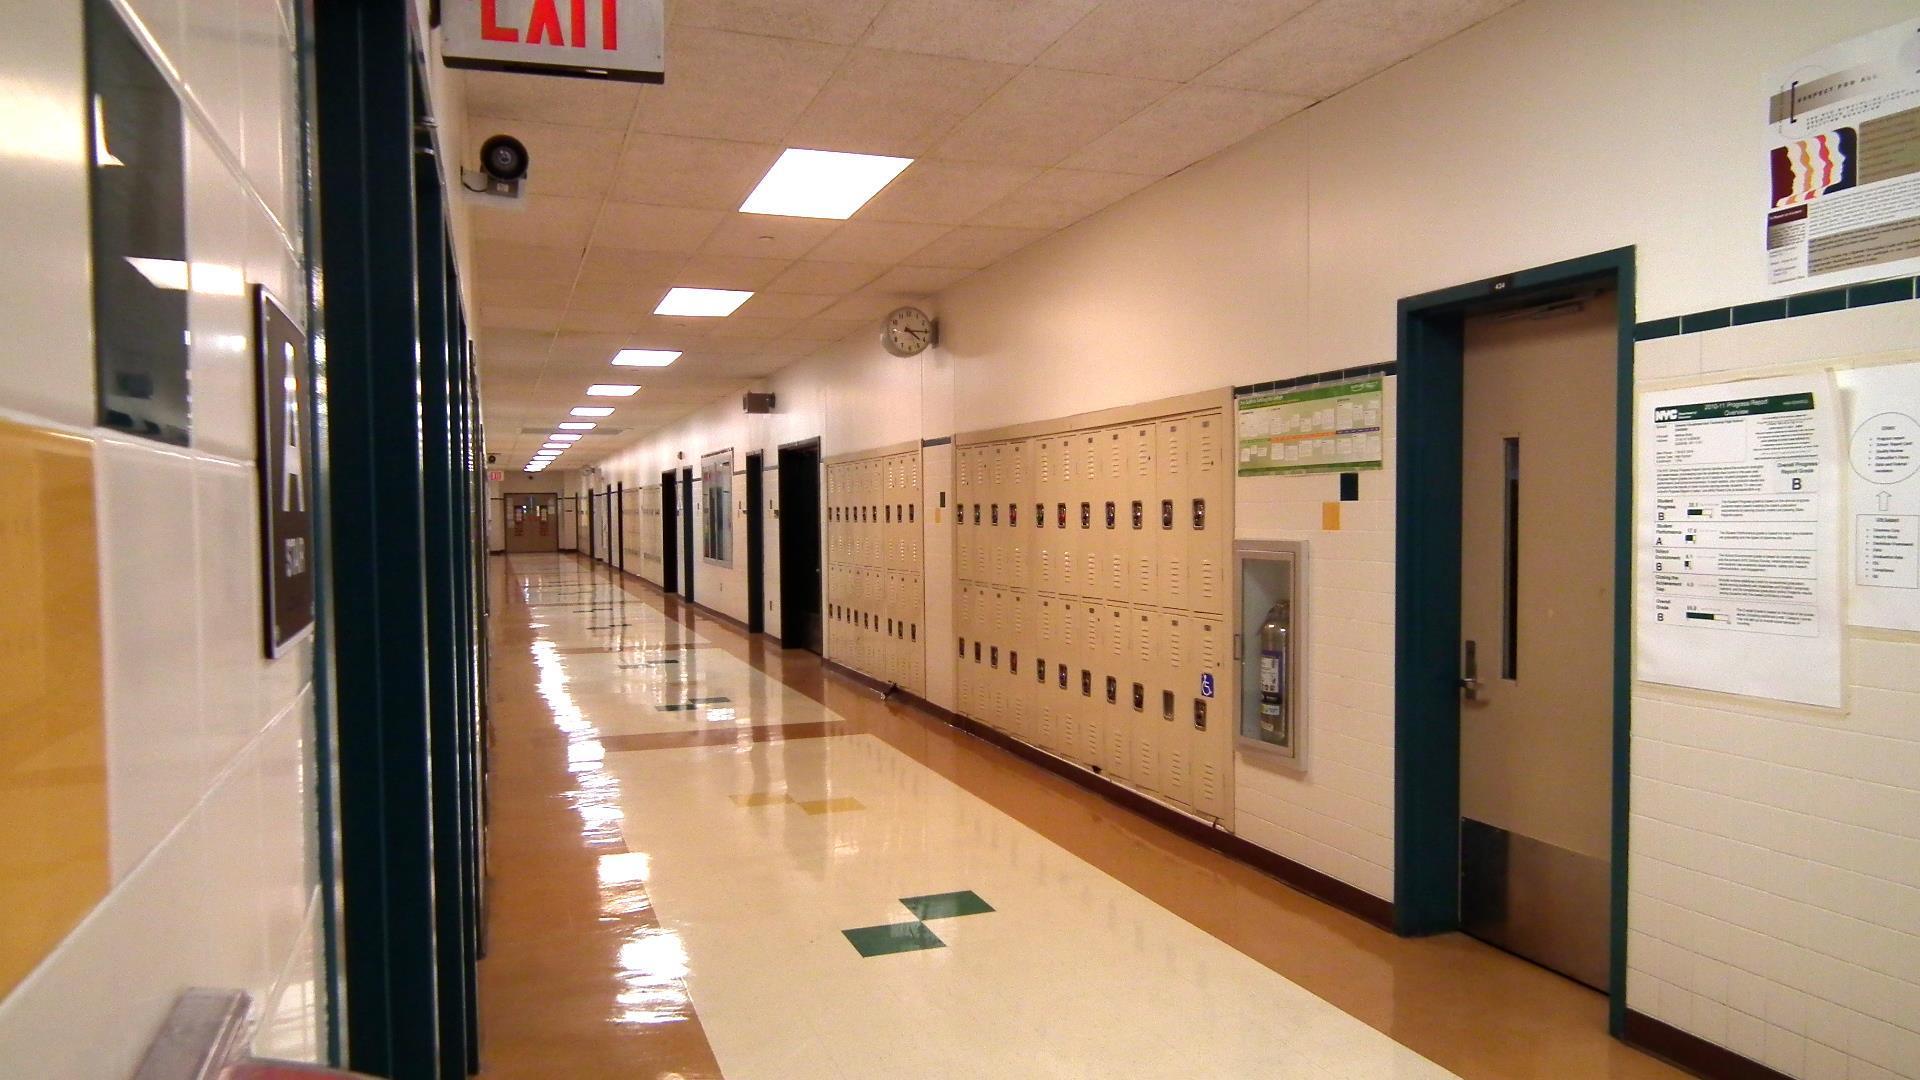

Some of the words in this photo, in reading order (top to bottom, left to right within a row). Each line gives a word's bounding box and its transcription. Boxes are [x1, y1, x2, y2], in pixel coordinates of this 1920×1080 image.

[1655, 409, 1678, 421] NYC
[281, 340, 305, 513] A
[1792, 478, 1801, 490] B
[1658, 512, 1664, 520] B
[1656, 537, 1663, 545] A
[1656, 563, 1662, 571] B
[1657, 613, 1664, 621] B
